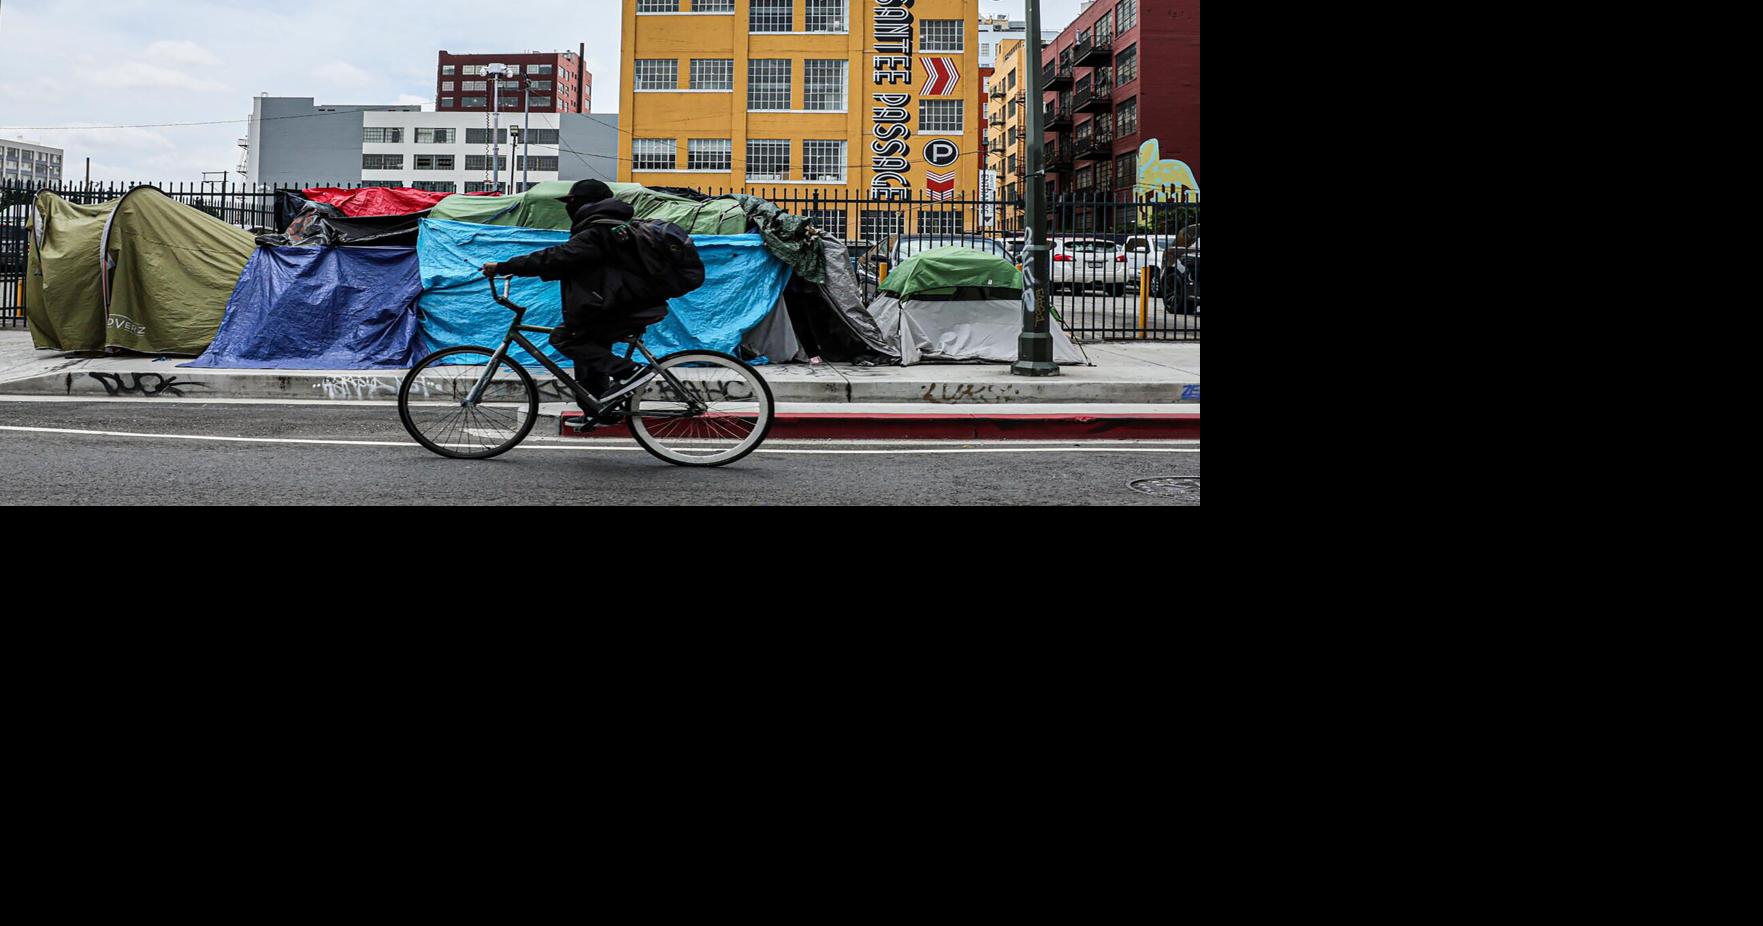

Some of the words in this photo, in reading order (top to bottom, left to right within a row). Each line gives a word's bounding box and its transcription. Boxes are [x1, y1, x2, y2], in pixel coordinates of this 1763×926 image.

[873, 0, 914, 84] ANTEE
[871, 92, 911, 200] PASSAGE
[932, 143, 953, 163] P
